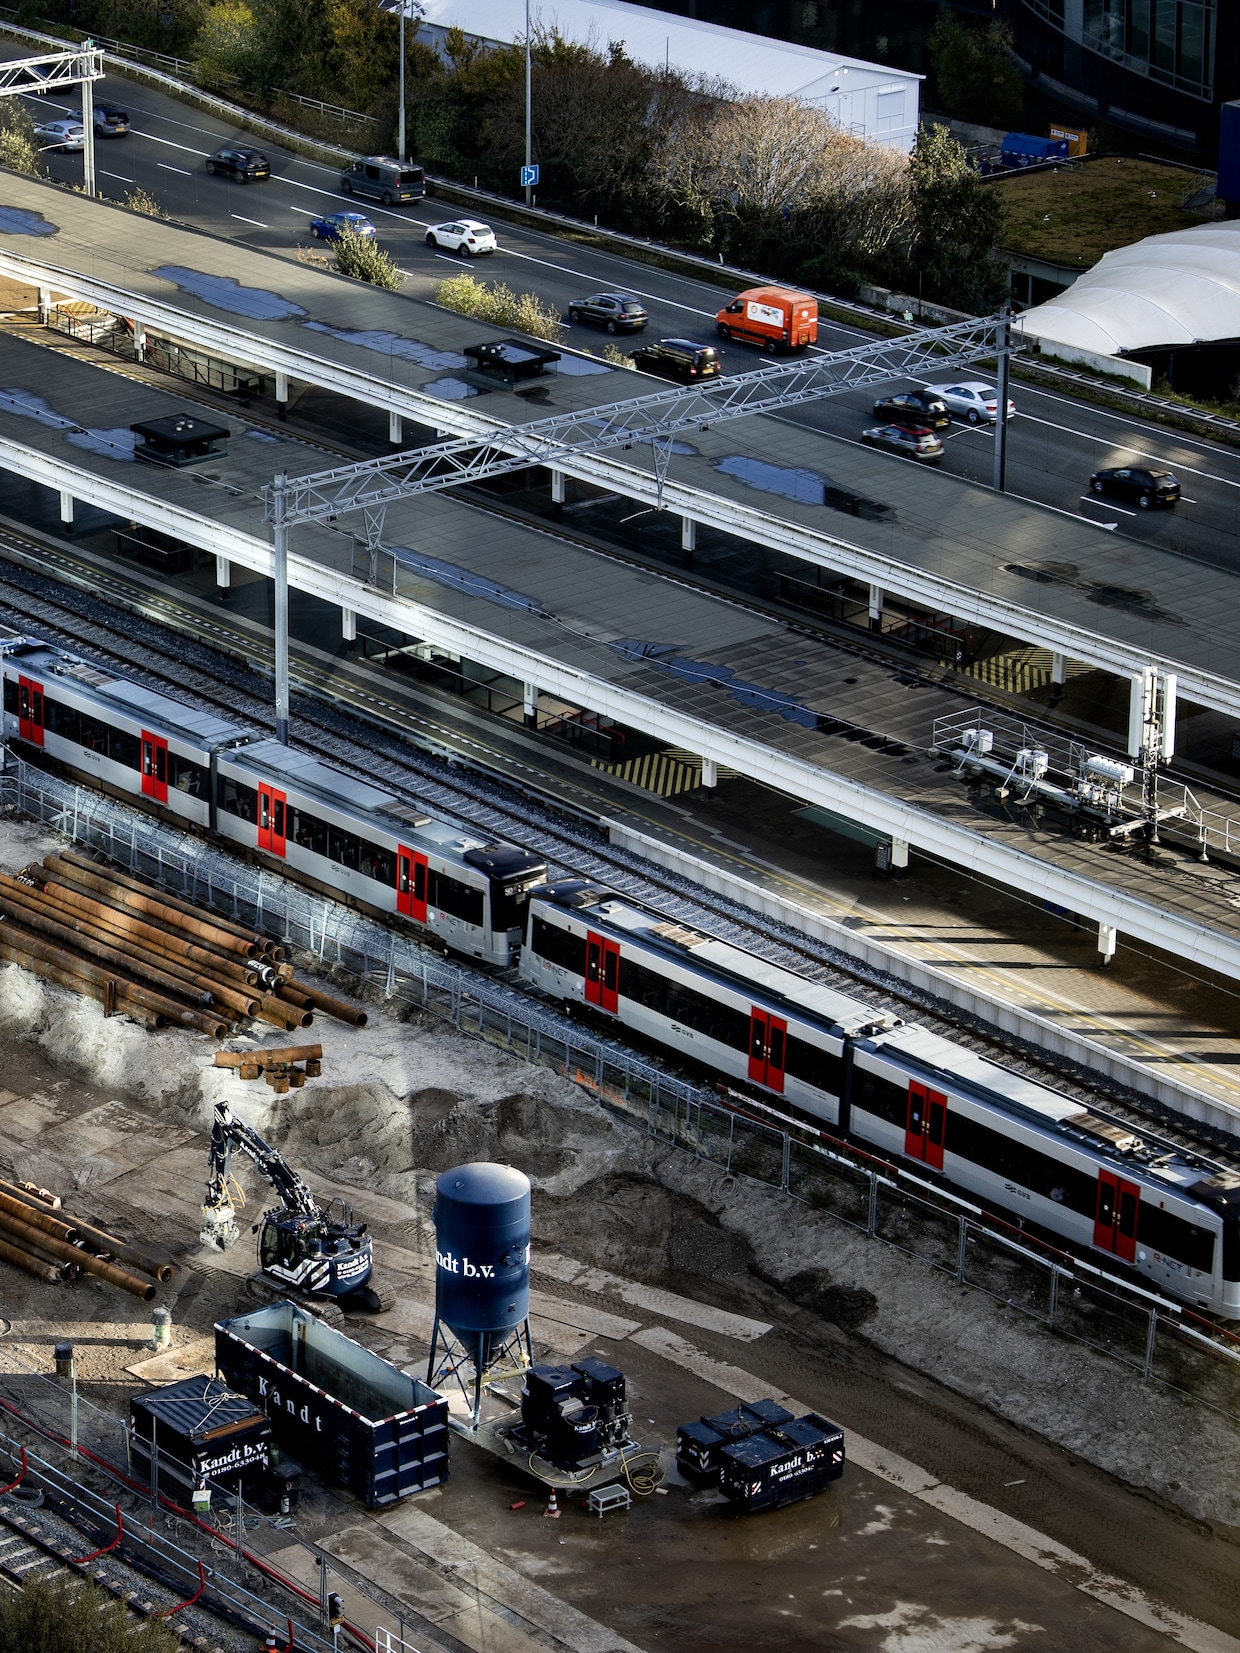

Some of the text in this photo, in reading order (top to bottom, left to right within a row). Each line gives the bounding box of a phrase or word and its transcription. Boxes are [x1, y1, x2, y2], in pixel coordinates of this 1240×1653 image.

[436, 1248, 496, 1278] ndt b.v.
[200, 1442, 268, 1473] Kandt b.v.
[769, 1456, 802, 1477] Kandt
